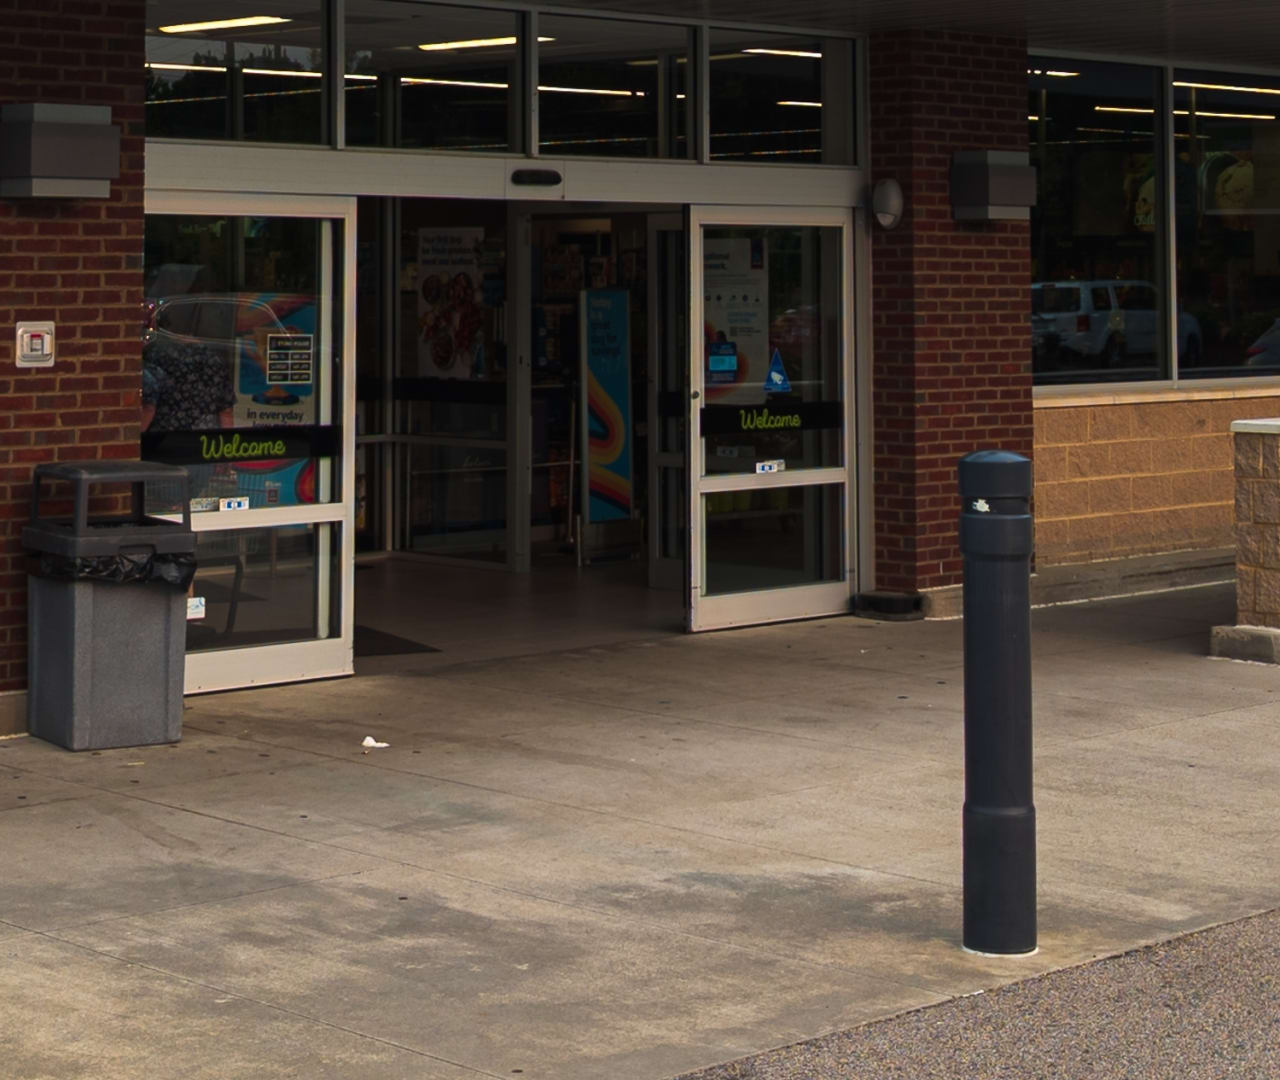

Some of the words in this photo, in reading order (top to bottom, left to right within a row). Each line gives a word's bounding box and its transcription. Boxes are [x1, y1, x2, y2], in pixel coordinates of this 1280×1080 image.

[246, 407, 257, 419] in
[259, 410, 305, 423] everyday
[738, 408, 802, 431] Welcome
[199, 433, 287, 460] Welcome
